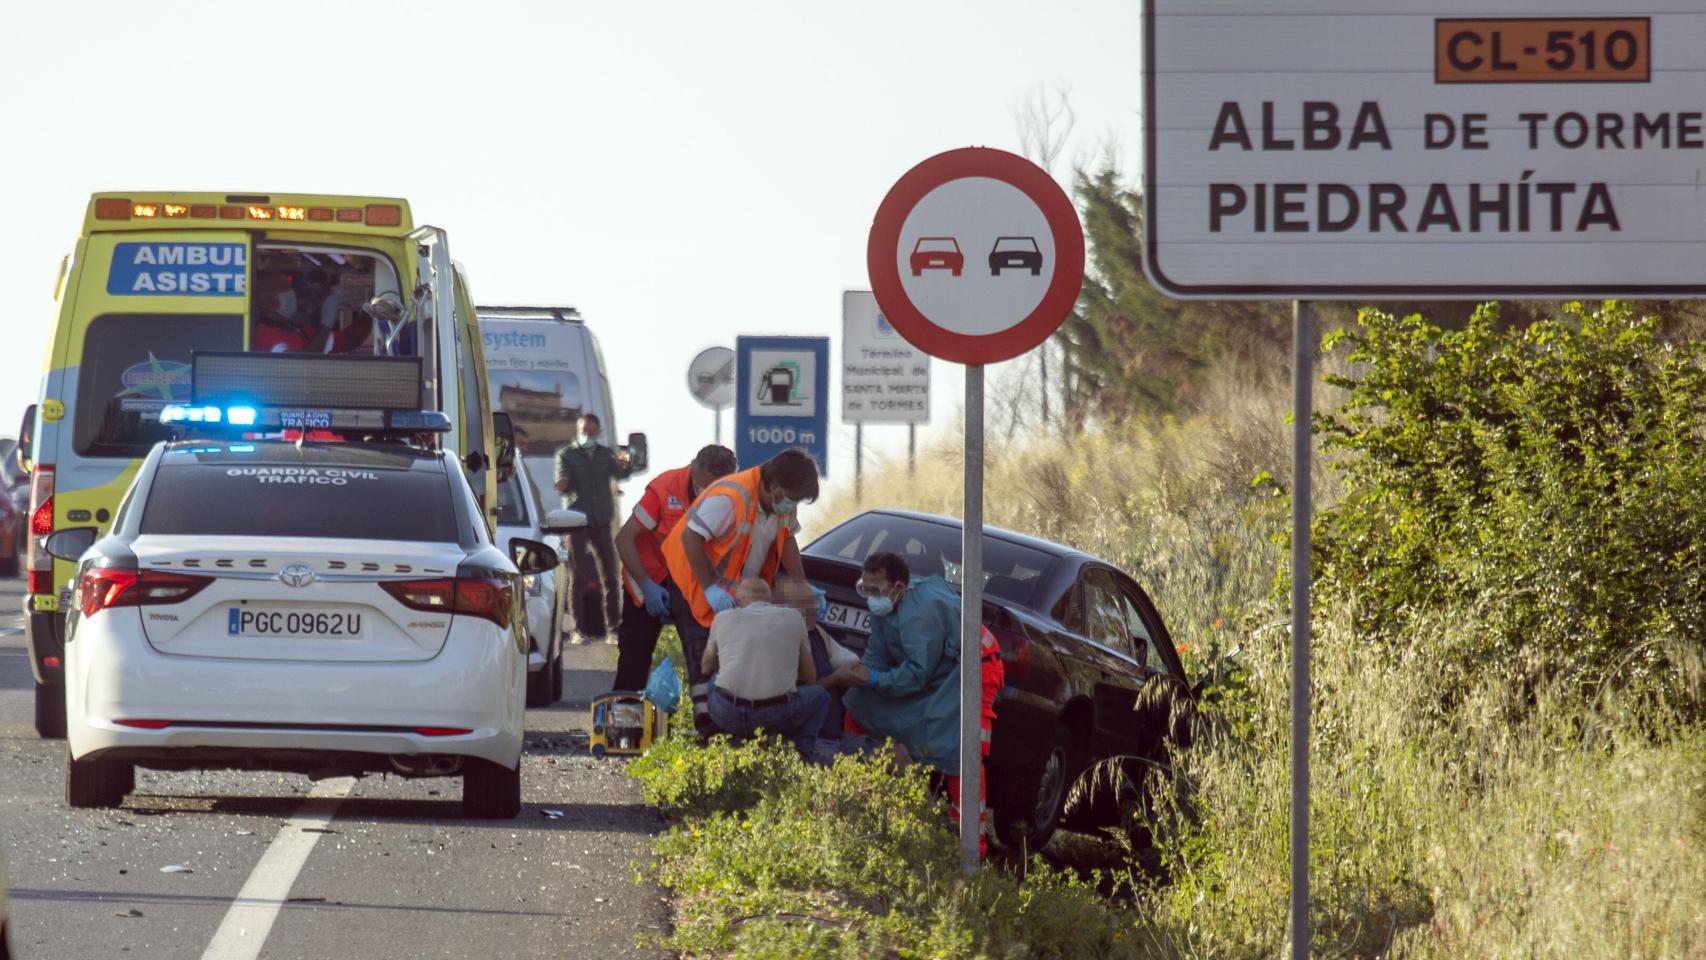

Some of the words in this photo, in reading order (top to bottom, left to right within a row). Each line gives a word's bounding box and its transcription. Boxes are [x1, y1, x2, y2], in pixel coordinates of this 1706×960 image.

[1447, 30, 1638, 71] CL-510
[1208, 101, 1393, 150] ALBA
[1425, 113, 1489, 149] DE
[1209, 170, 1621, 232] PIEDRAHÍTA
[846, 365, 904, 378] Municipal
[911, 366, 927, 376] de
[843, 384, 882, 394] SANTA
[888, 384, 928, 394] MARTA
[847, 401, 862, 411] de
[870, 400, 925, 411] TORMES
[749, 428, 796, 444] 1000
[799, 432, 816, 445] m
[226, 467, 319, 477] GUARDIA
[325, 469, 379, 480] CIVIL
[256, 475, 348, 486] TRAFICO
[149, 613, 180, 622] TOYOTA
[827, 606, 848, 625] SA
